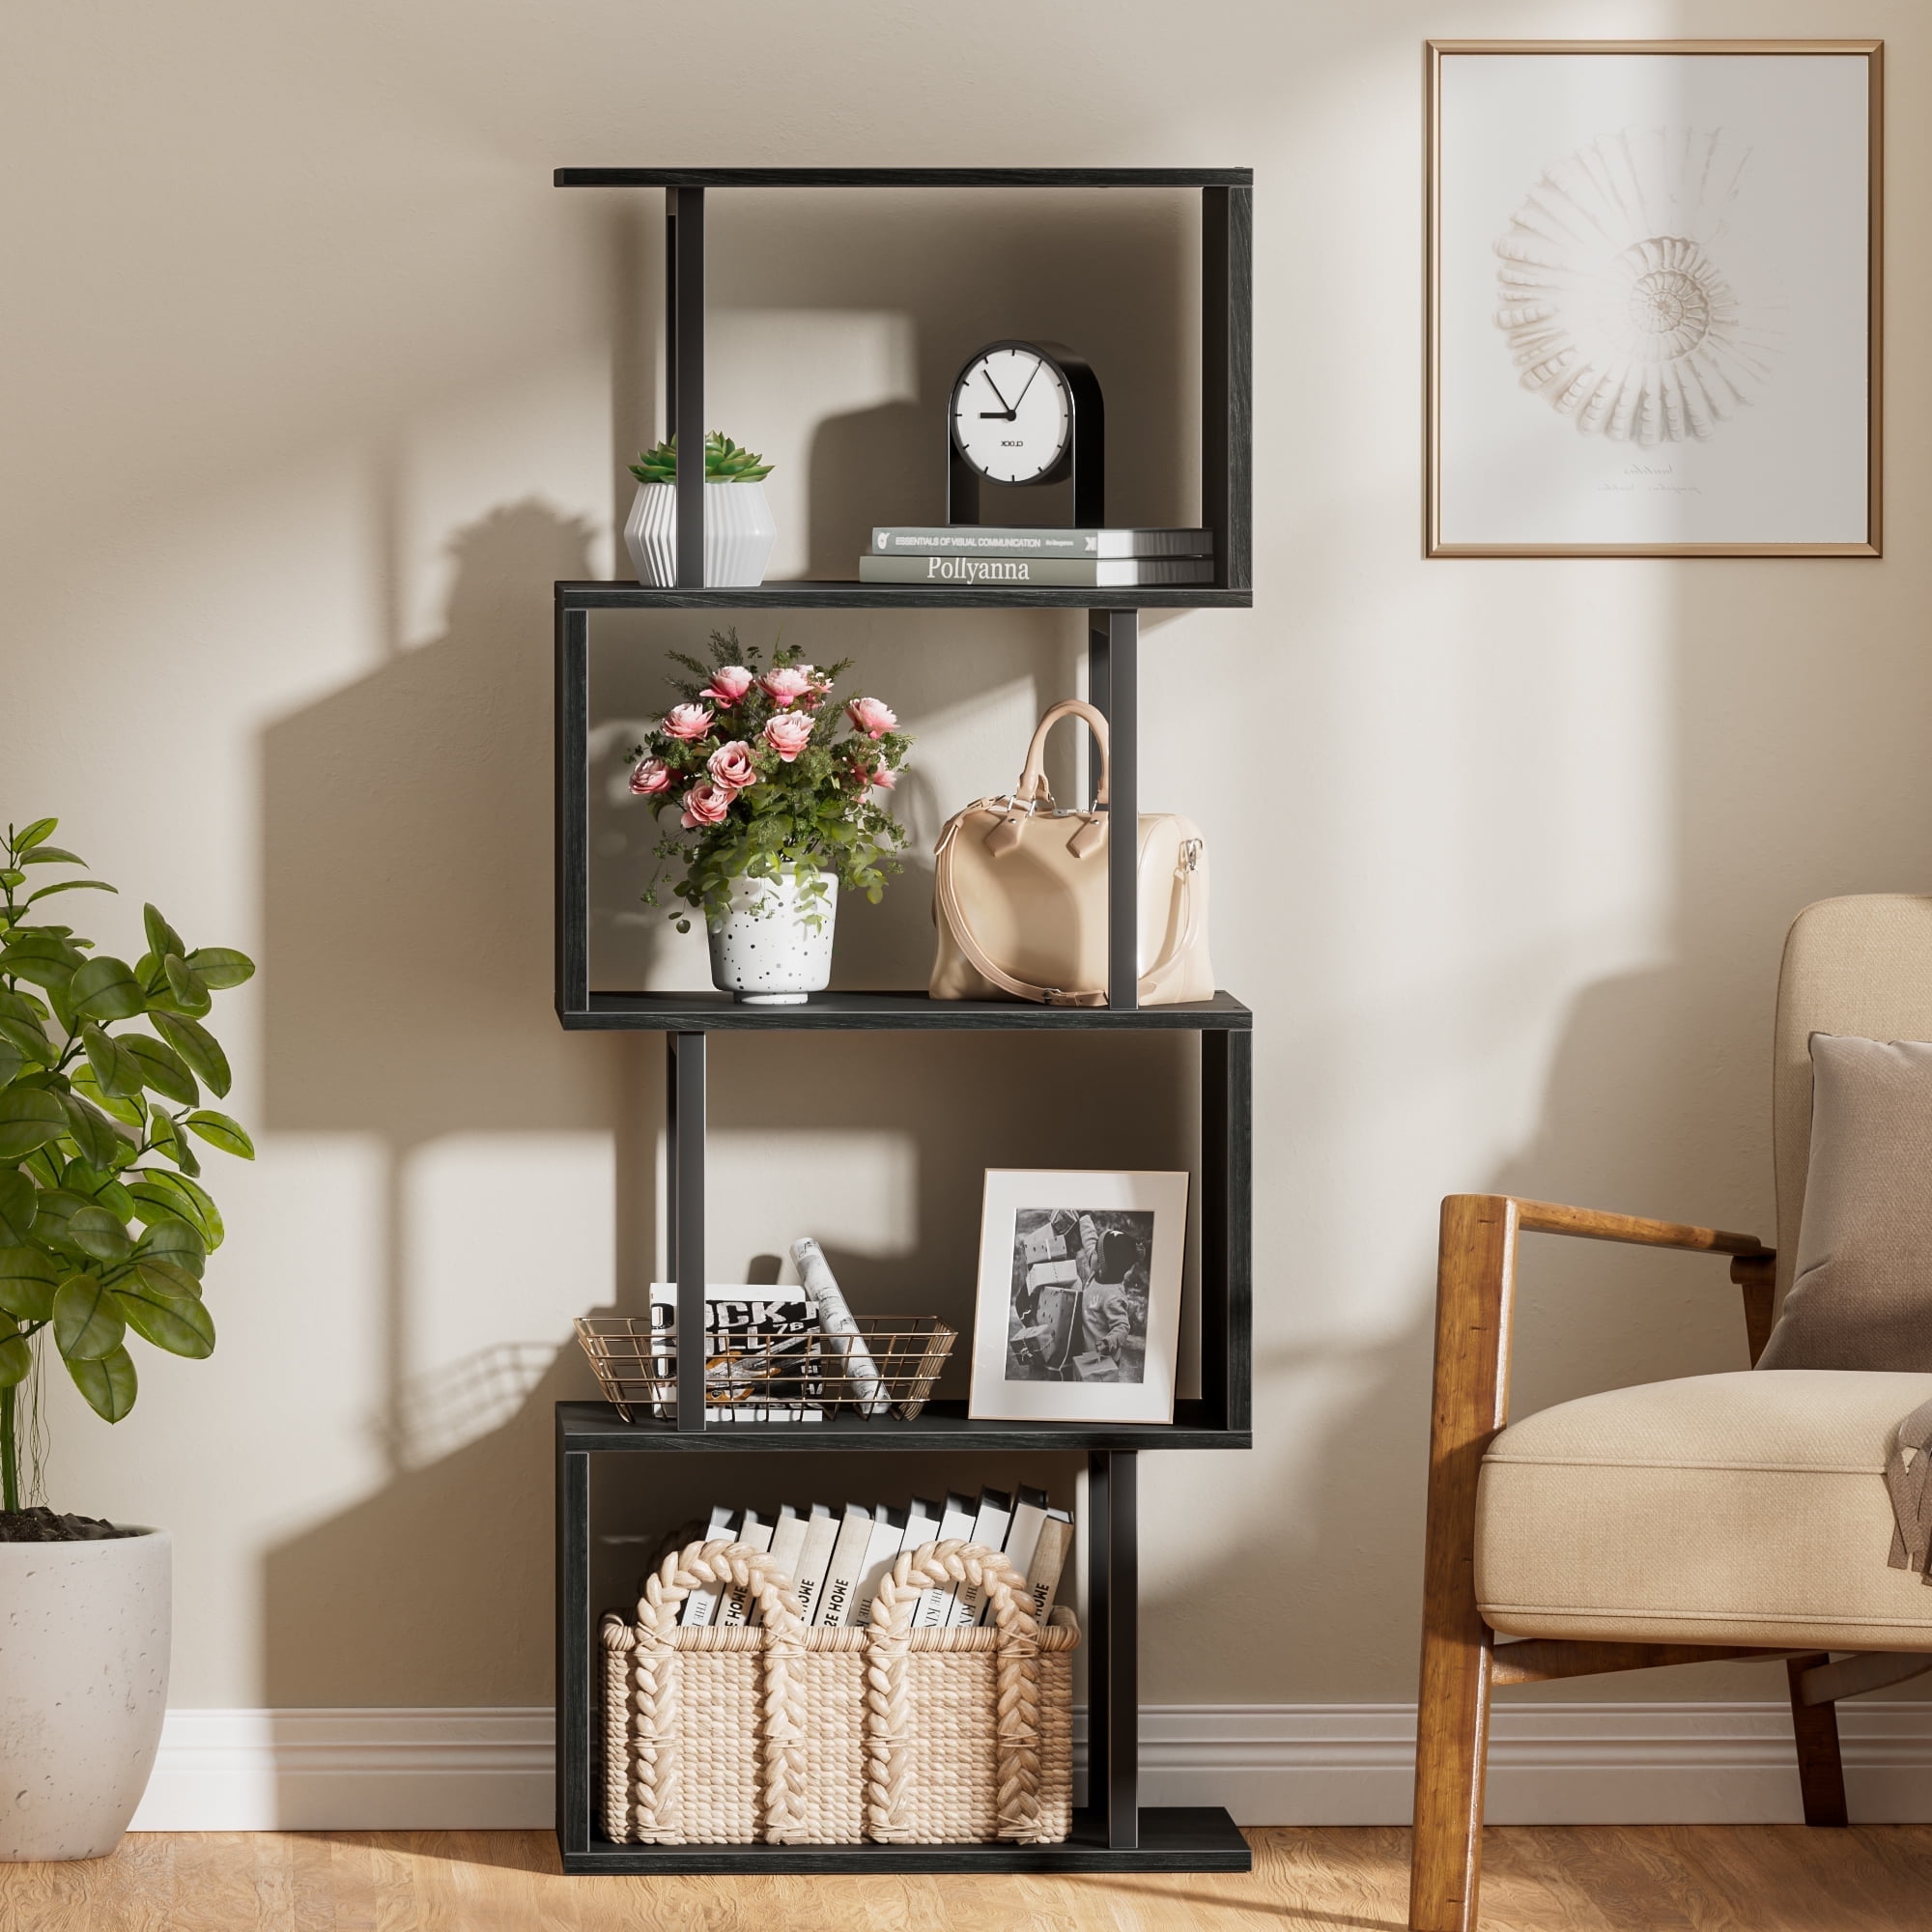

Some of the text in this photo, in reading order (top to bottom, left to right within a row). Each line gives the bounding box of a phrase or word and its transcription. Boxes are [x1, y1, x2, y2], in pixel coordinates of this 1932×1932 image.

[895, 536, 938, 546] ESSENTIALS
[940, 537, 951, 547] OF
[952, 537, 977, 547] VISUAL
[978, 537, 1041, 548] COMMUNICATION
[926, 557, 1030, 584] Pollyanna
